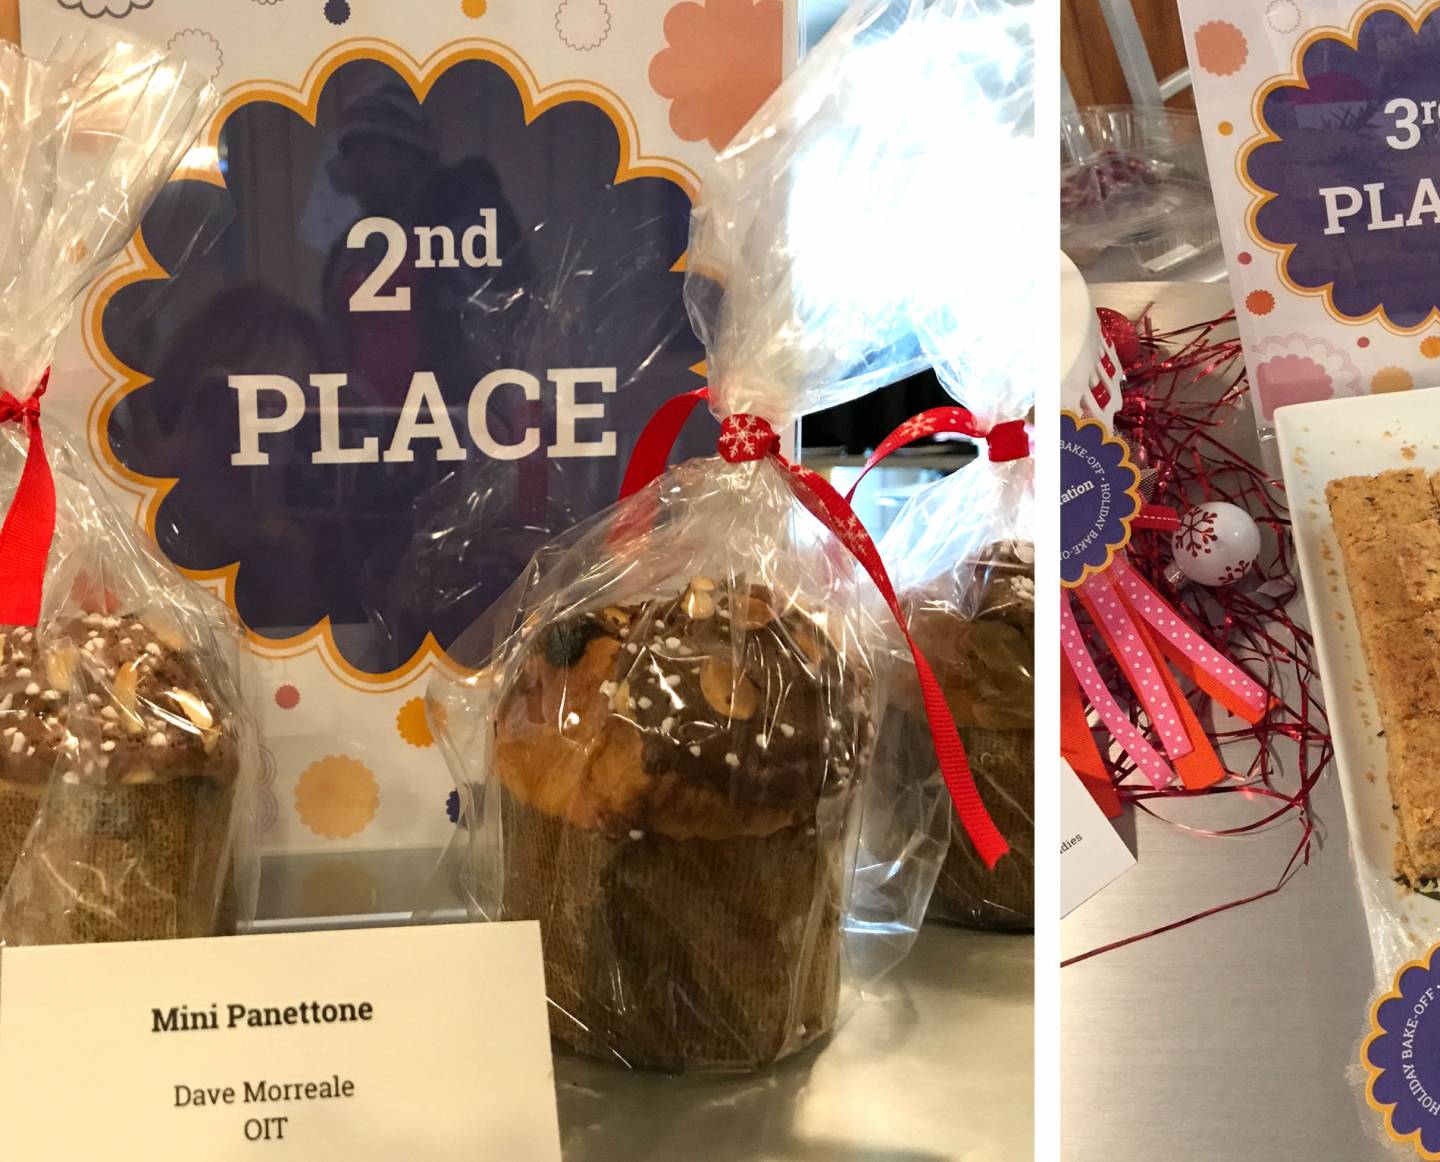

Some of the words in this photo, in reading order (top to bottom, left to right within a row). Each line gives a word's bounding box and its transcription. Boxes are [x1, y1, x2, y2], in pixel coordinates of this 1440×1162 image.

[346, 208, 502, 312] 2nd
[228, 367, 618, 466] PLACE
[1060, 440, 1105, 475] BAKE-OFF
[1096, 483, 1111, 531] HOLIDAY
[1060, 532, 1098, 561] BAKE-O
[151, 1004, 219, 1034] Mini
[226, 1000, 374, 1030] Panettone
[1401, 987, 1436, 1059] BAKE-OFF
[174, 1081, 236, 1108] Dave
[243, 1075, 356, 1104] Morreale
[244, 1117, 288, 1143] OIT
